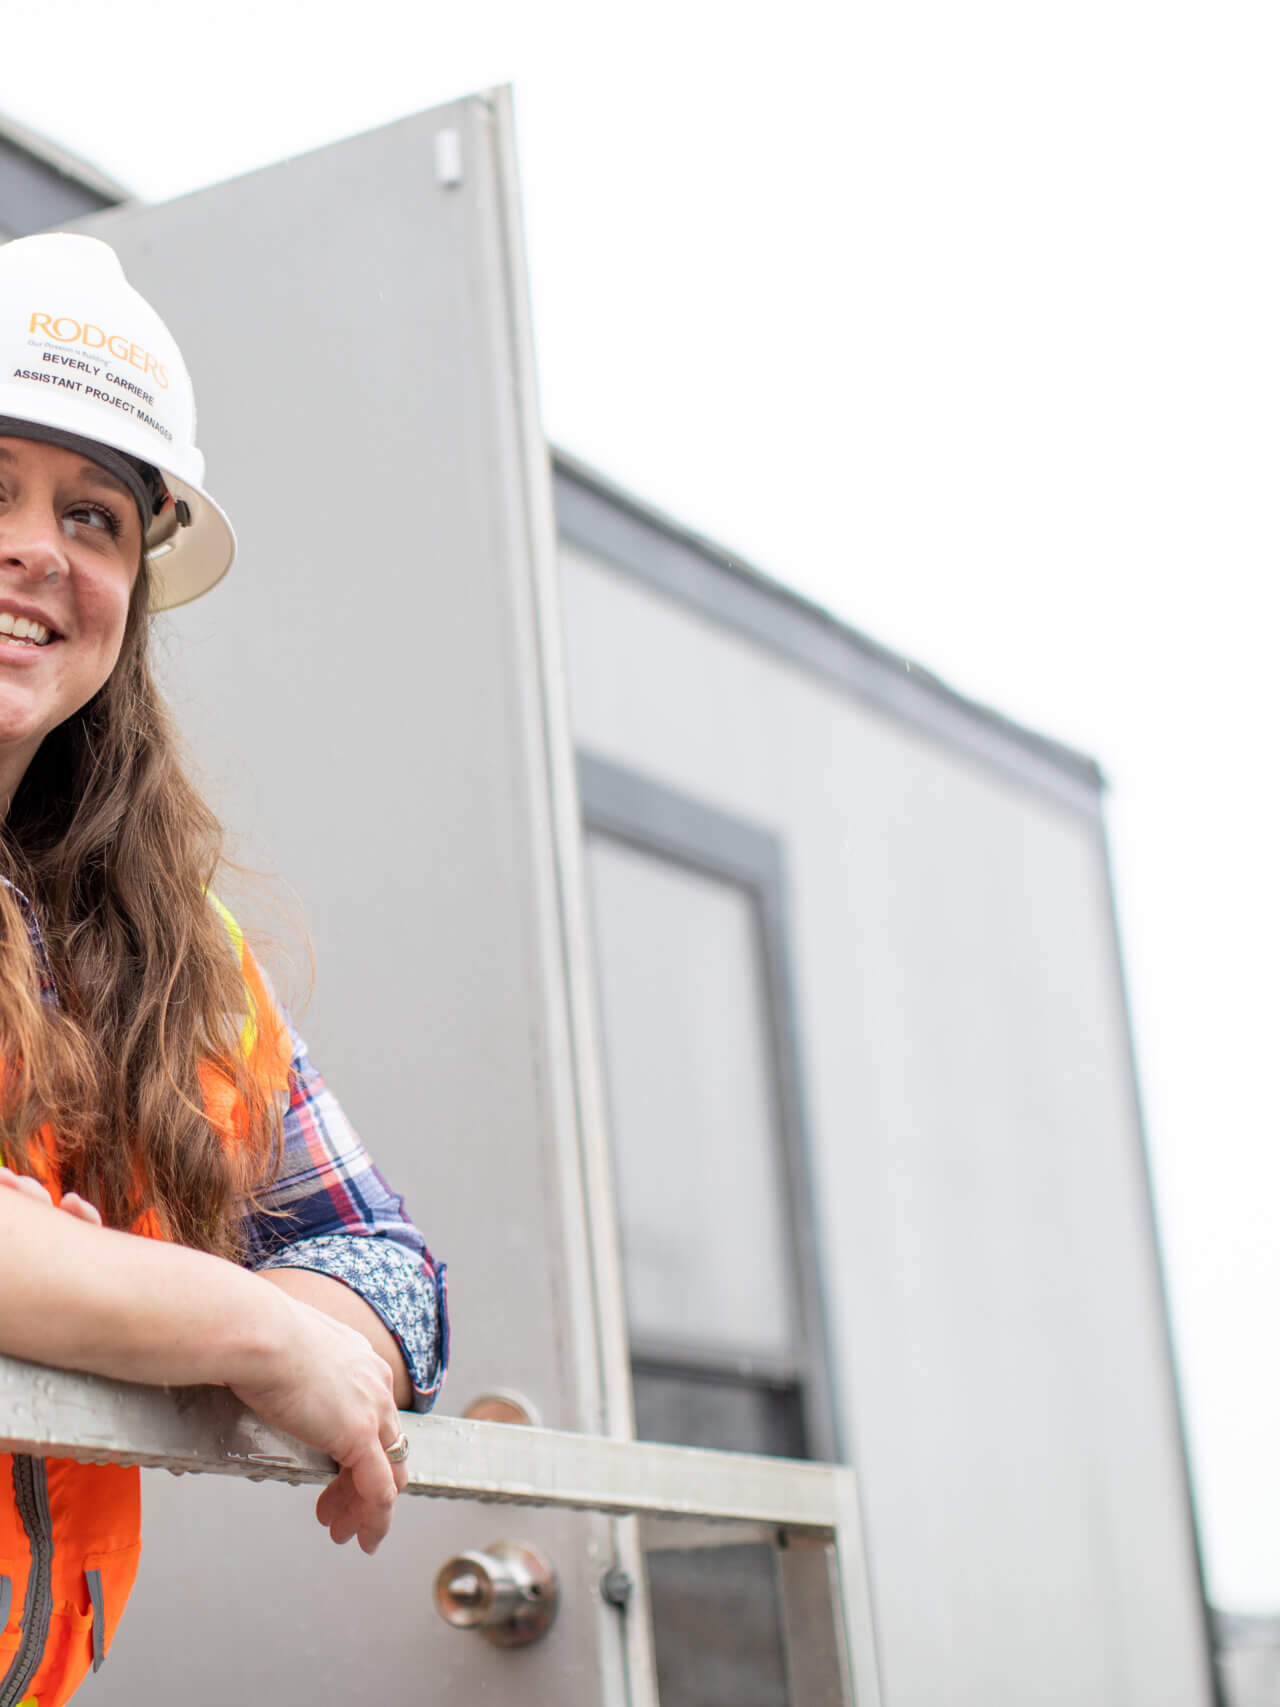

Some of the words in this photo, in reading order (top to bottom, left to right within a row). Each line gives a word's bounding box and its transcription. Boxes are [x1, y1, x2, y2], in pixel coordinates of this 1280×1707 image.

[28, 312, 169, 390] RODGERS
[42, 352, 101, 376] BEVERLY
[105, 372, 155, 406] CARRIERE
[14, 368, 83, 392] ASSISTANT
[84, 385, 136, 415] PROJECT
[136, 409, 173, 441] MANAGER
